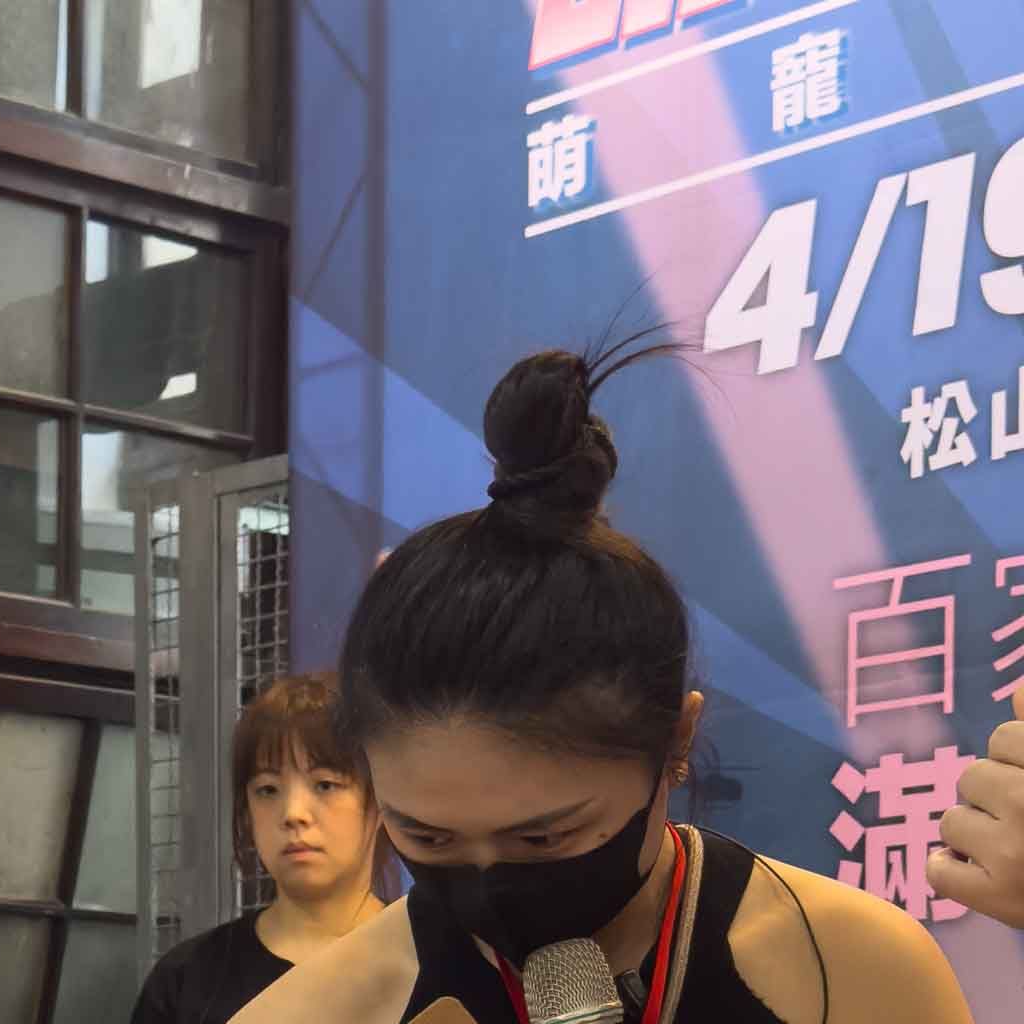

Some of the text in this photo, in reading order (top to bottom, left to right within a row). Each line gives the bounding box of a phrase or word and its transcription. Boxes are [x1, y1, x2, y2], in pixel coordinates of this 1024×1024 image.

[527, 115, 594, 208] 萌
[771, 28, 846, 133] 寵
[832, 553, 1024, 728] 百
